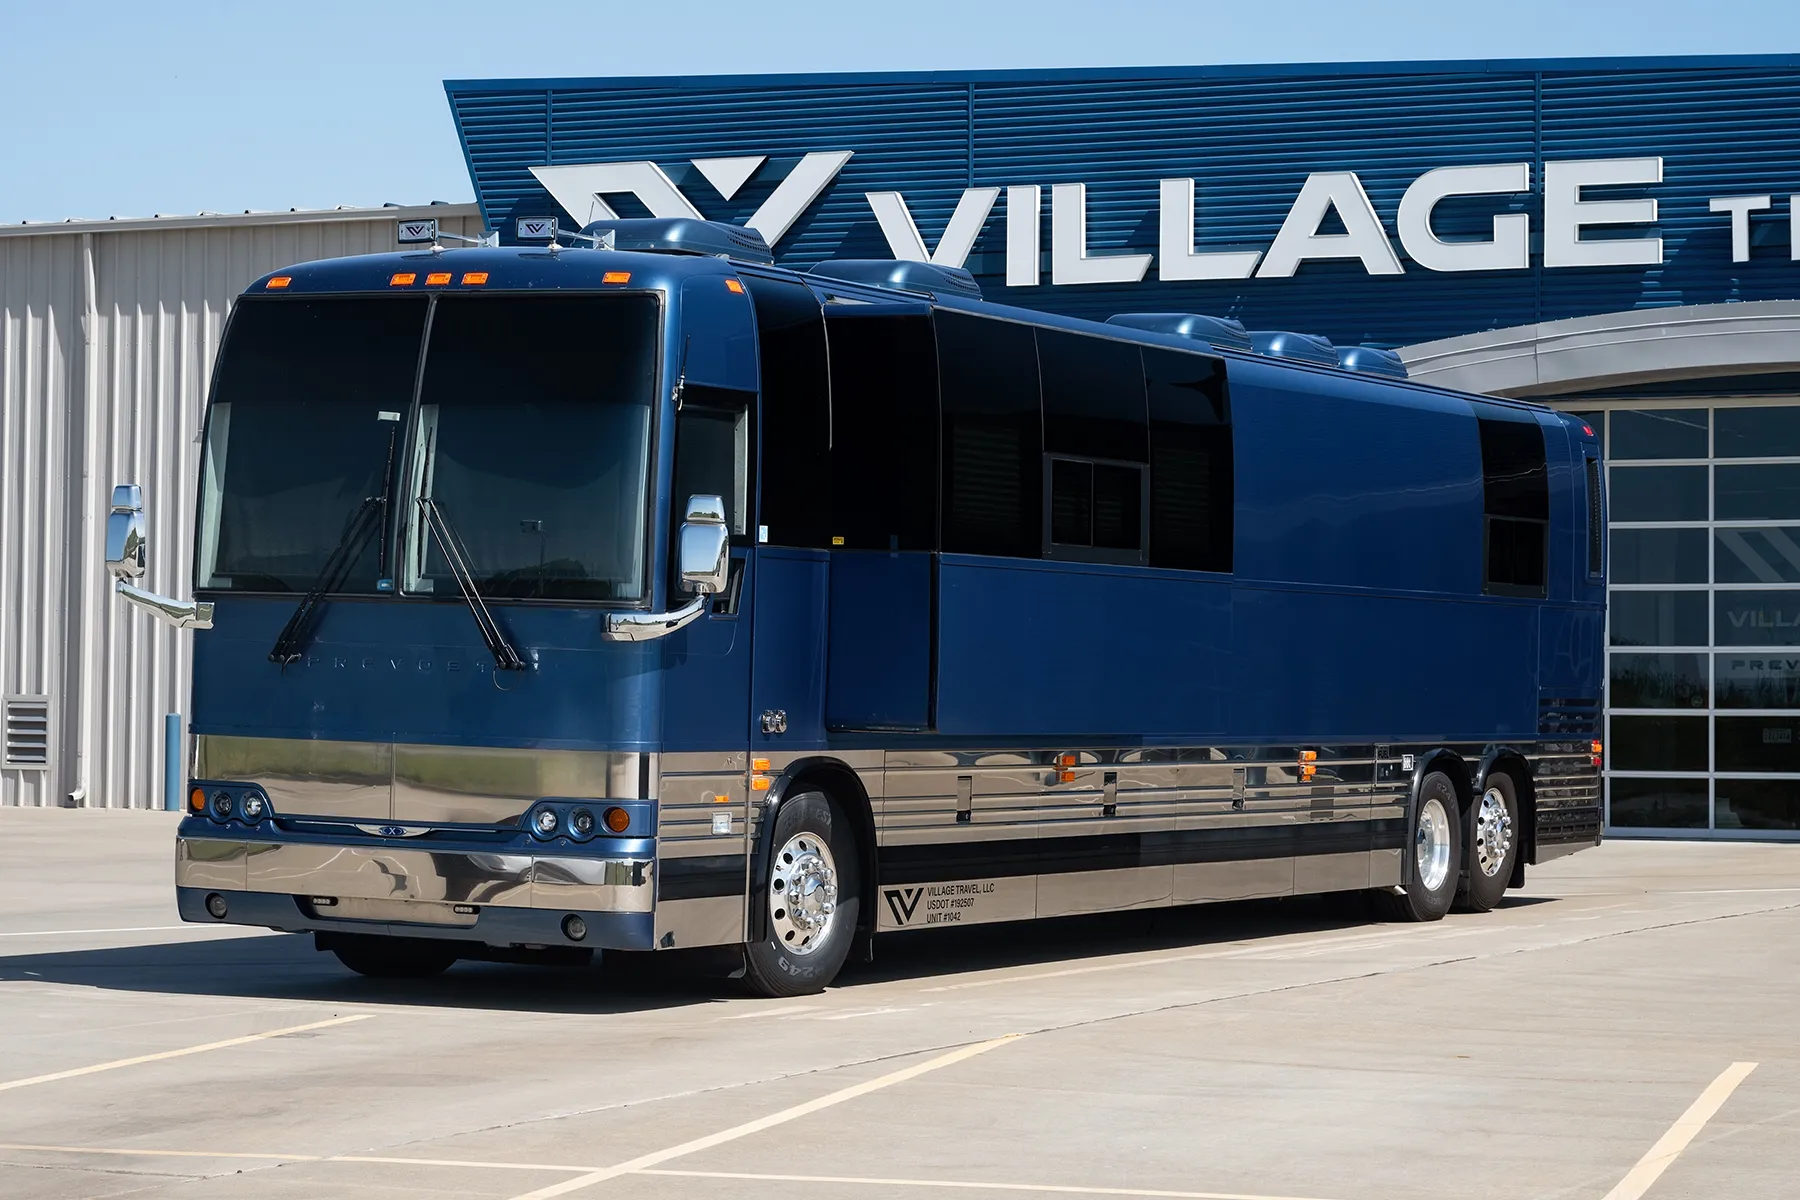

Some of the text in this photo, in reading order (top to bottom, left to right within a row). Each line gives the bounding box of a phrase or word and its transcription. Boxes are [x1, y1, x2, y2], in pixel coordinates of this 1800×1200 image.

[865, 156, 1664, 286] VILLAGE
[307, 657, 488, 674] PREVOST
[927, 882, 995, 897] VILLAGE TRAVEL, LLC
[926, 897, 975, 910] USDOT #192507
[926, 911, 961, 923] UNIT #1042
